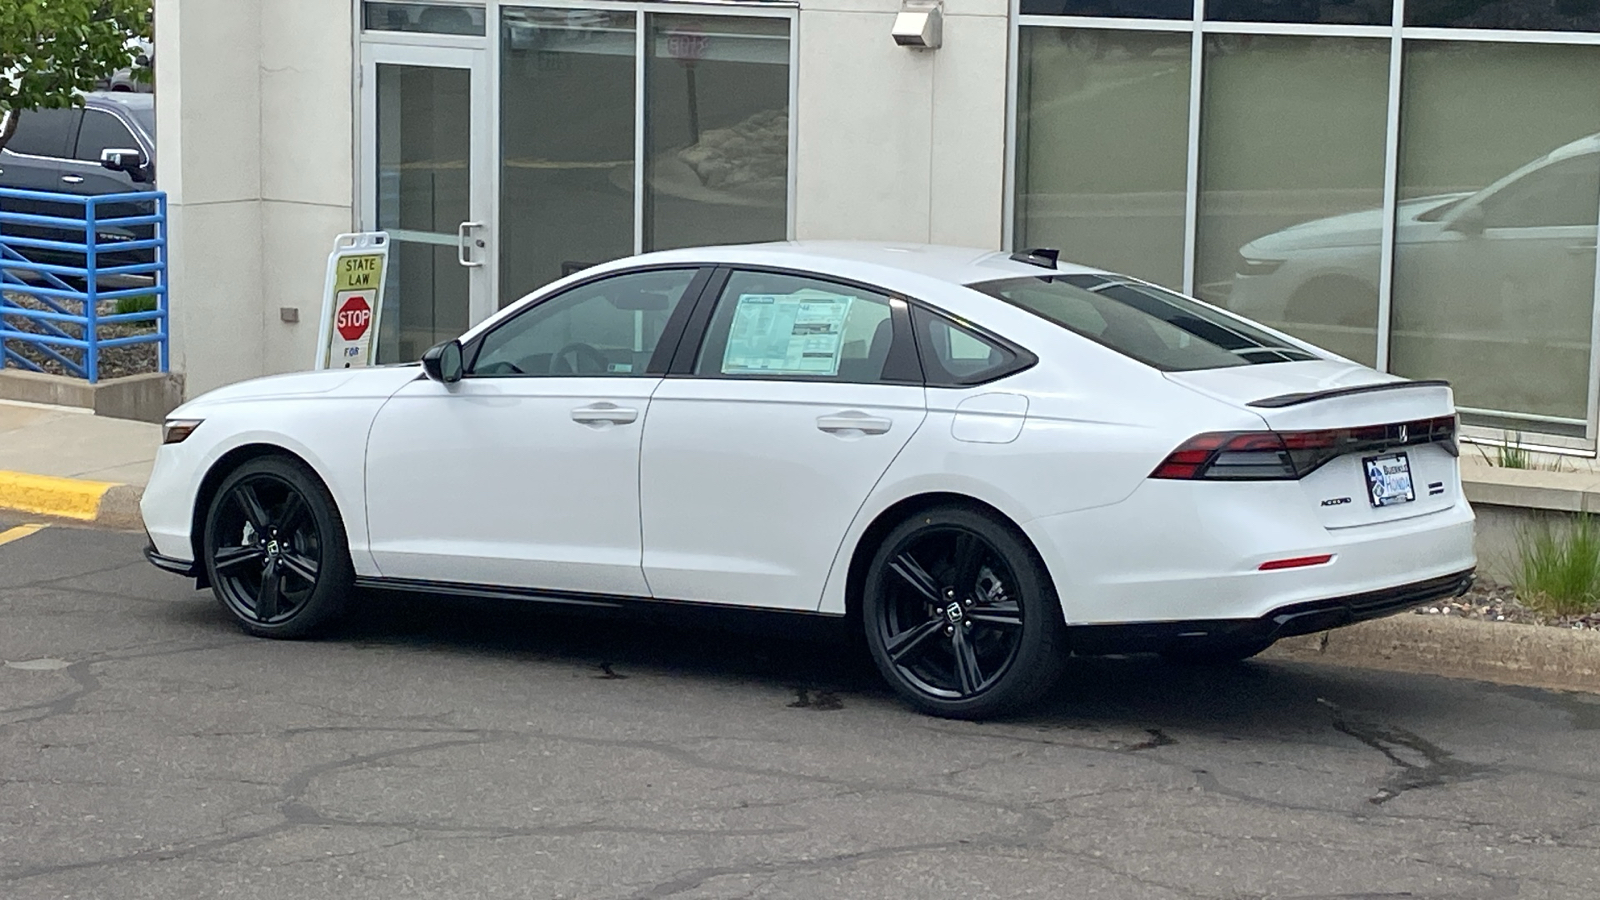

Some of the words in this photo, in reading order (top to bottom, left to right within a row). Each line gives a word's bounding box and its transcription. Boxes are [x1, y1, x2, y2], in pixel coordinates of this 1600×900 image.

[346, 259, 375, 272] STATE
[348, 274, 370, 286] LAW
[338, 309, 370, 328] STOP
[344, 347, 359, 357] FOR
